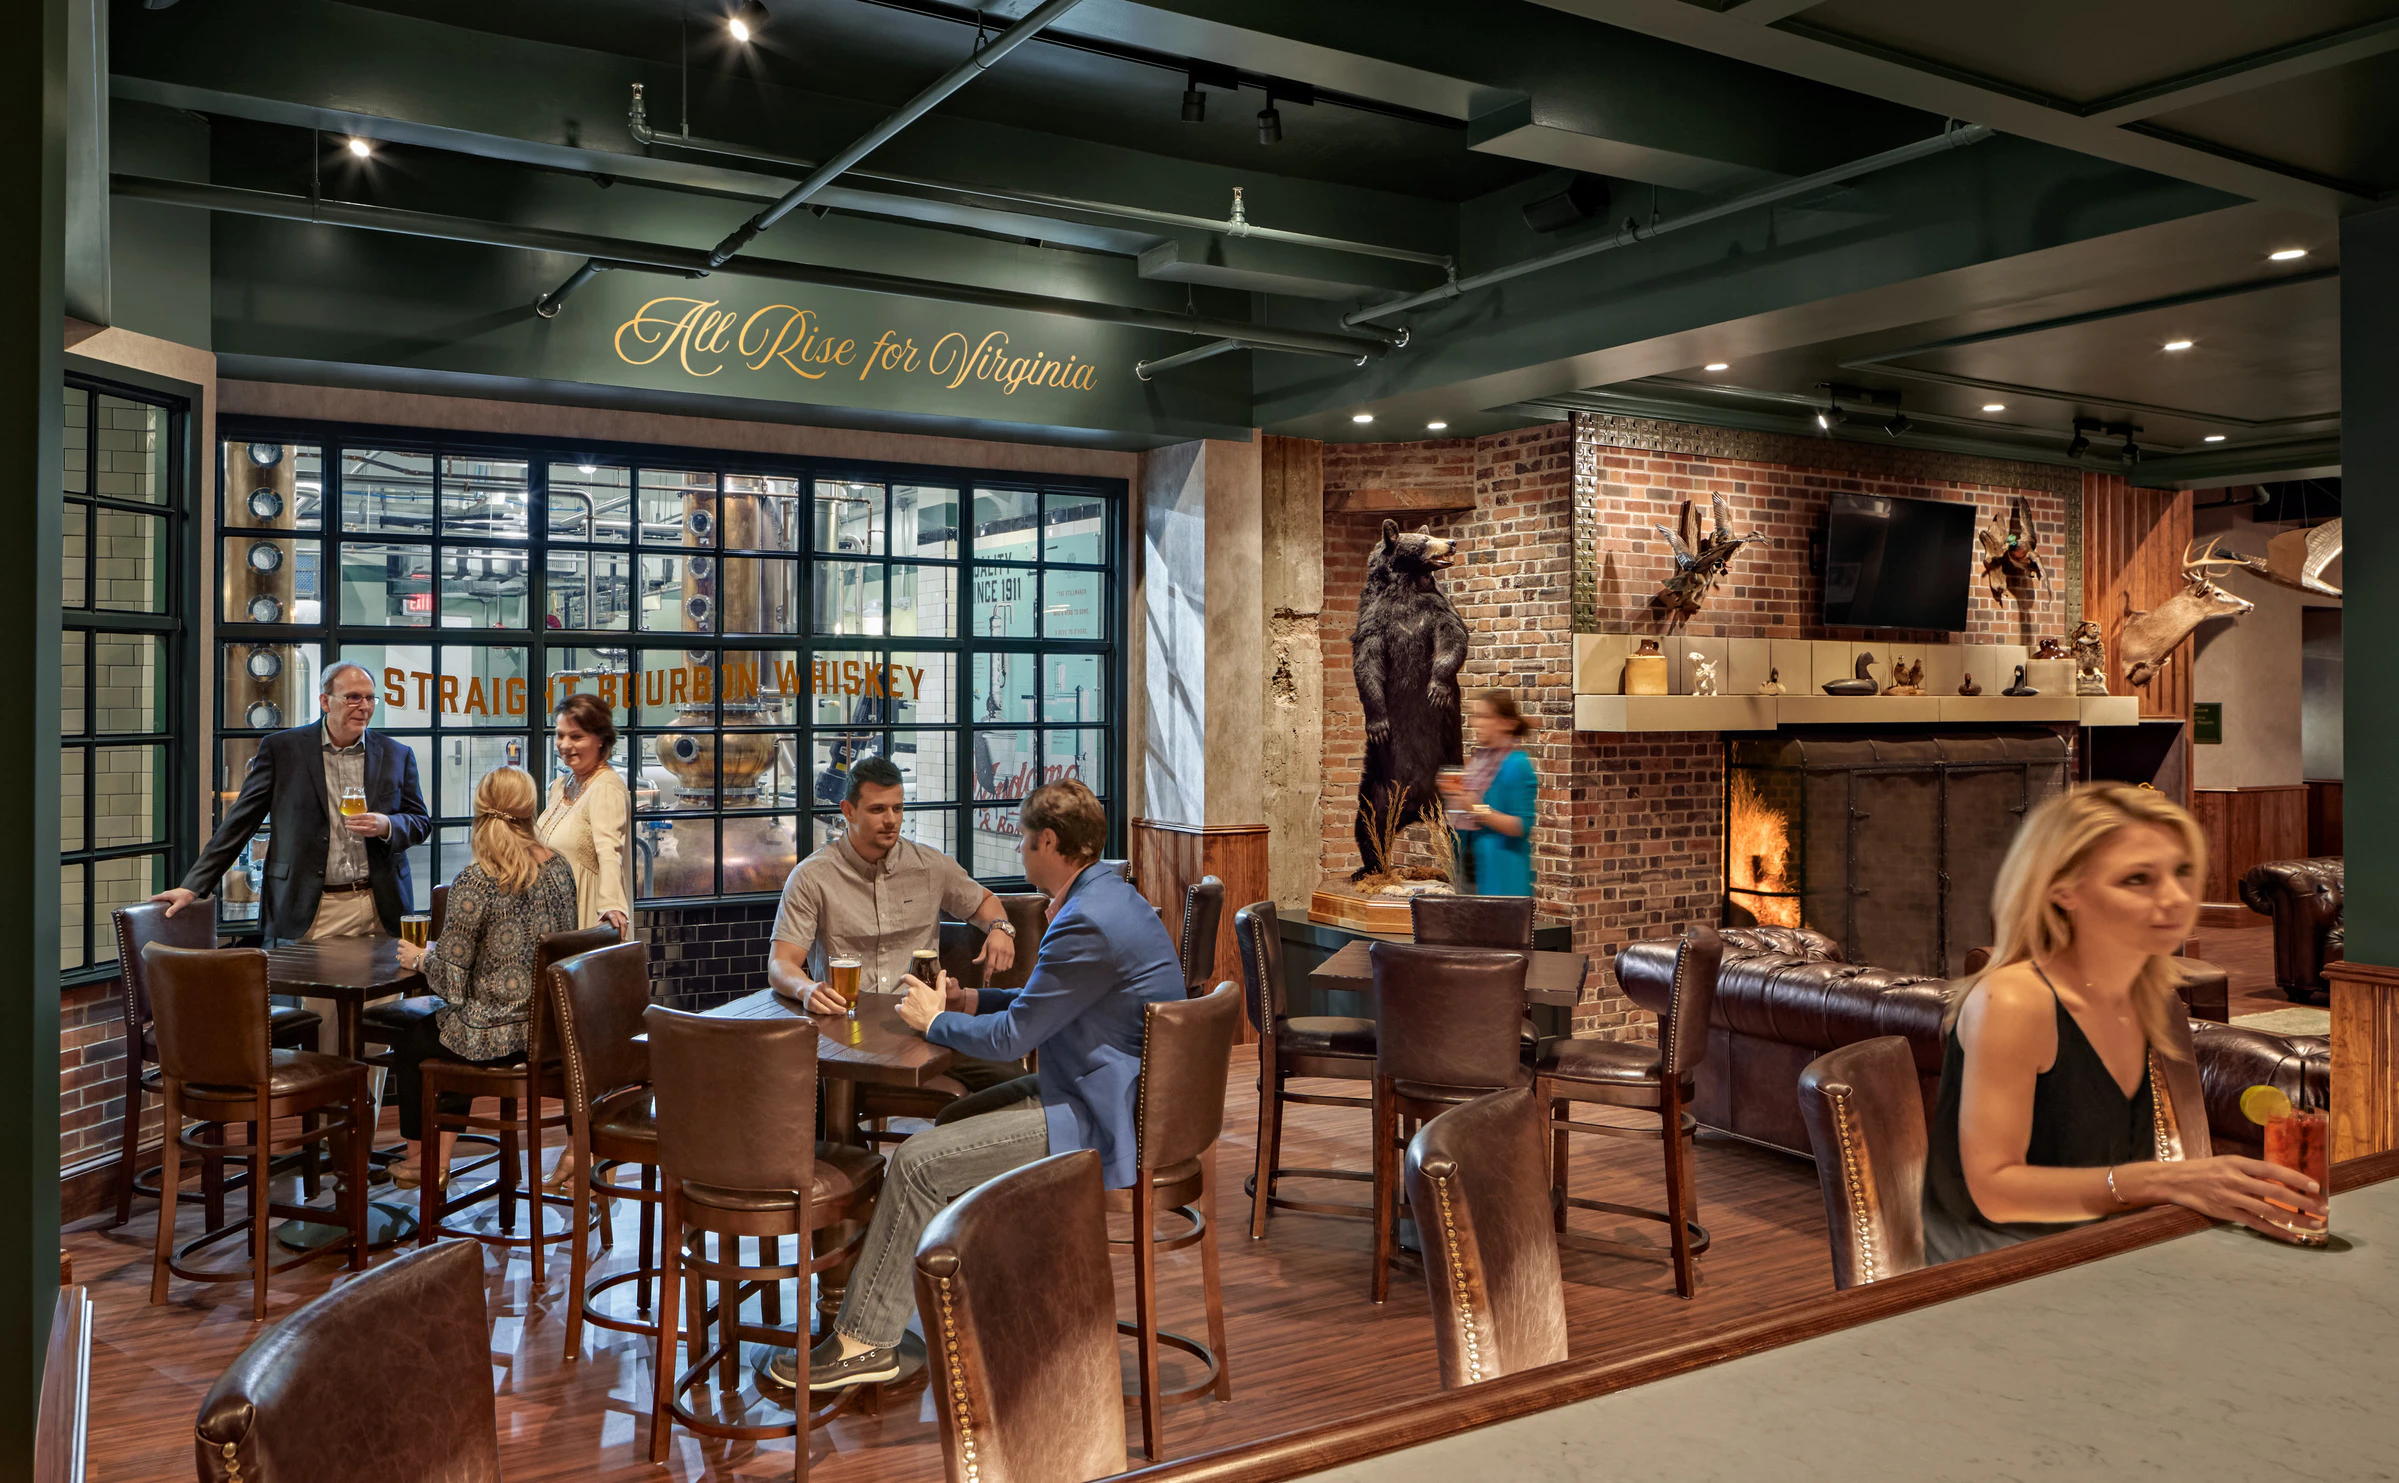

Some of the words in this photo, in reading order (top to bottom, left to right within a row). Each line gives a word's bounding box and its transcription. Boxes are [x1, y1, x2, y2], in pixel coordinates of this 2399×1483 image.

[614, 297, 736, 377] All
[739, 305, 856, 380] Rise
[859, 331, 920, 381] for
[929, 331, 1098, 395] Virginia
[973, 580, 998, 604] INCE
[1001, 577, 1021, 602] 1911
[598, 662, 758, 710] BOURBON
[774, 660, 924, 700] WHISKEY
